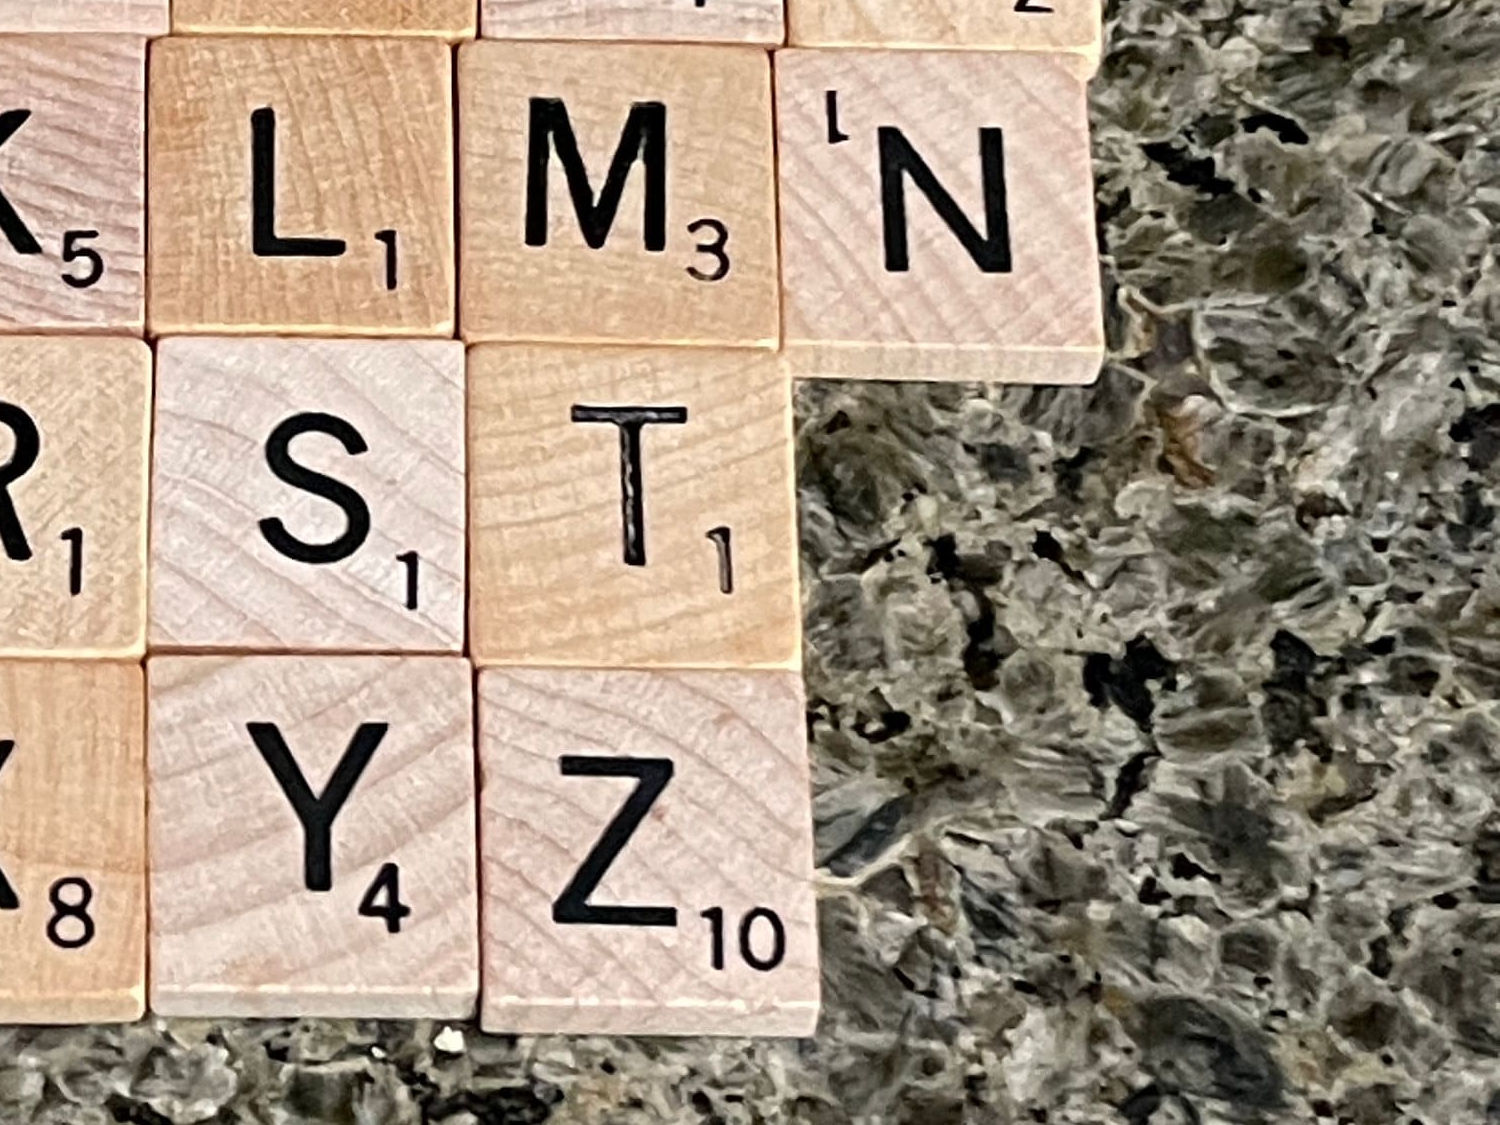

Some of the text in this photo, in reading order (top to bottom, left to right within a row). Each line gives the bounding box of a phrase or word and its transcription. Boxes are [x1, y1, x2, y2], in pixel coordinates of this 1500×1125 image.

[61, 230, 104, 289] 5
[250, 106, 398, 291] L 1
[524, 96, 730, 281] M 3
[877, 126, 1013, 274] N
[60, 527, 83, 596] 1
[258, 412, 419, 611] S 1
[570, 404, 733, 594] T 1
[46, 877, 95, 949] 8
[246, 721, 411, 934] Y 4
[552, 755, 786, 972] Z 10
